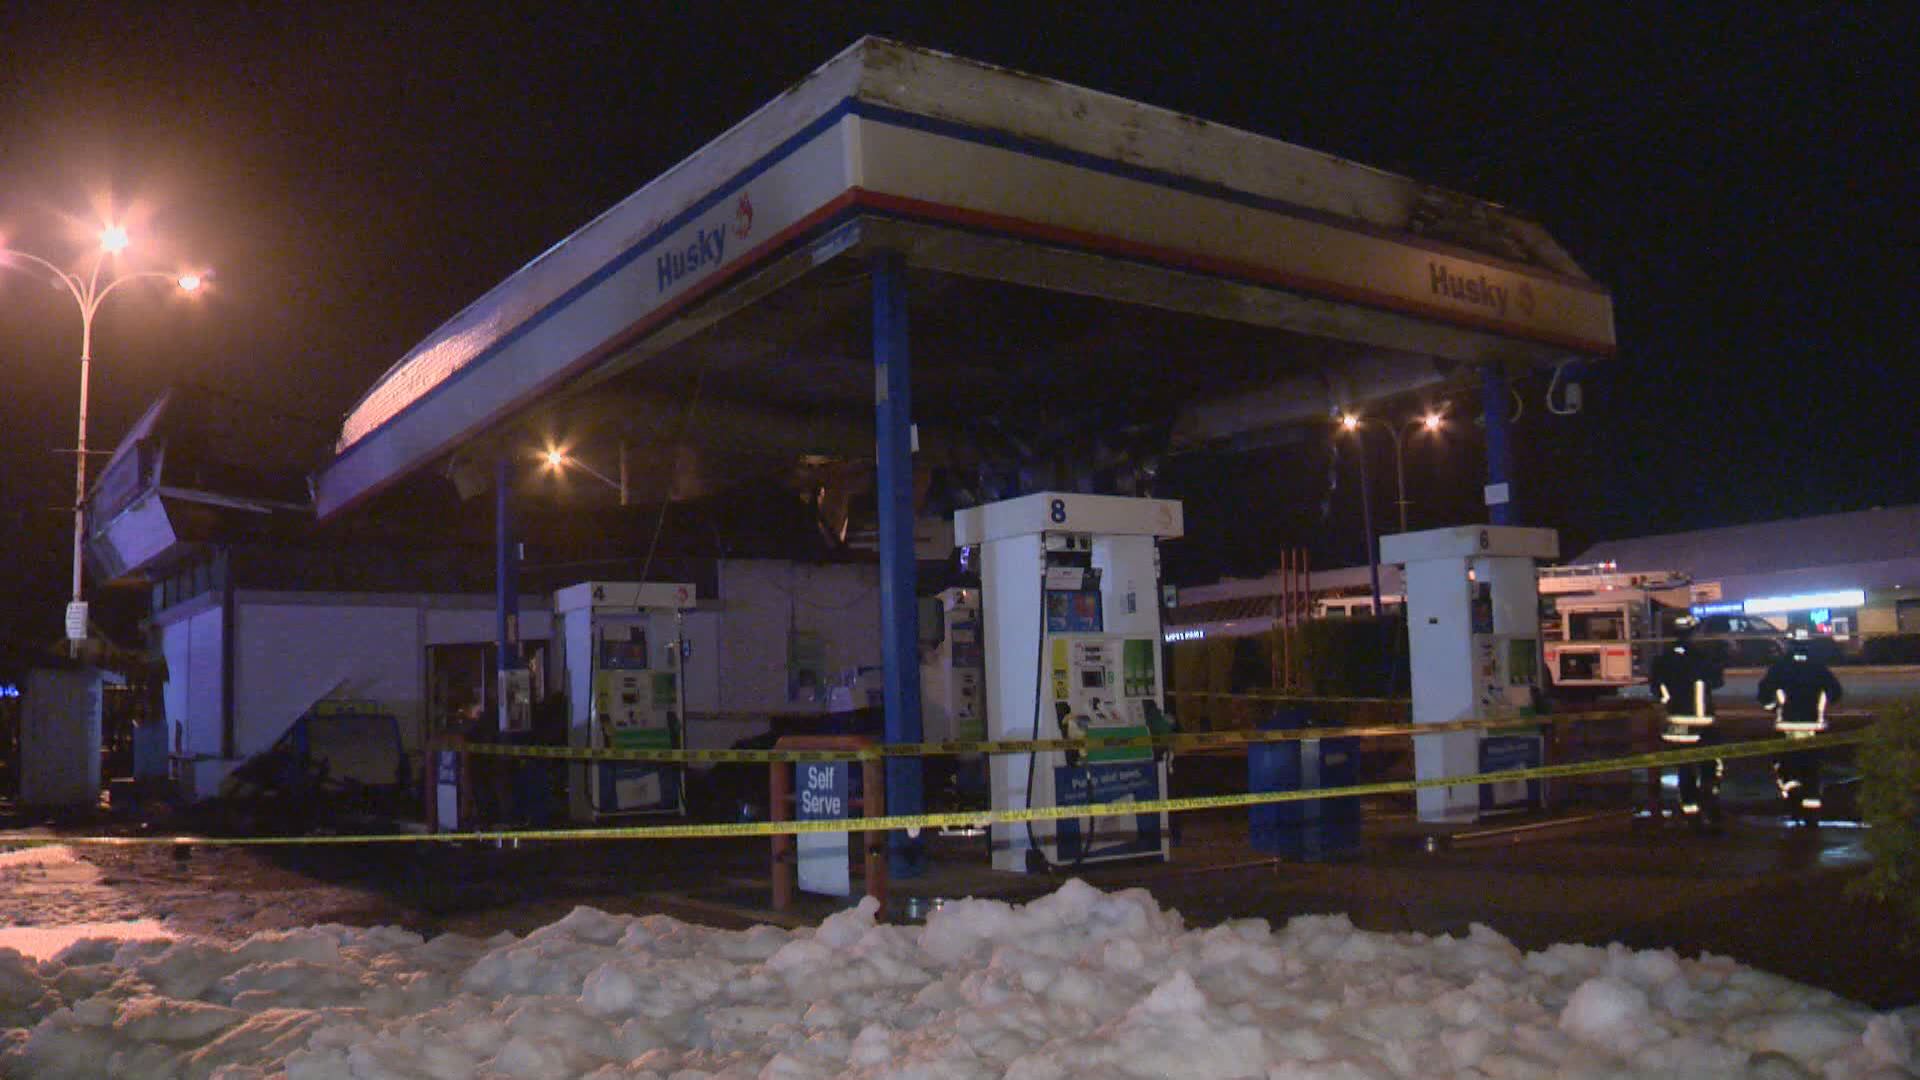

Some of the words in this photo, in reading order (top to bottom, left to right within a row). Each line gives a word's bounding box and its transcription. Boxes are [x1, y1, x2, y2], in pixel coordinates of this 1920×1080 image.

[657, 223, 726, 293] Husky
[1429, 262, 1508, 318] Husky
[1051, 499, 1066, 524] 8
[1479, 528, 1489, 550] 6
[593, 585, 604, 600] 4
[807, 766, 835, 790] Self
[801, 789, 841, 815] Serve
